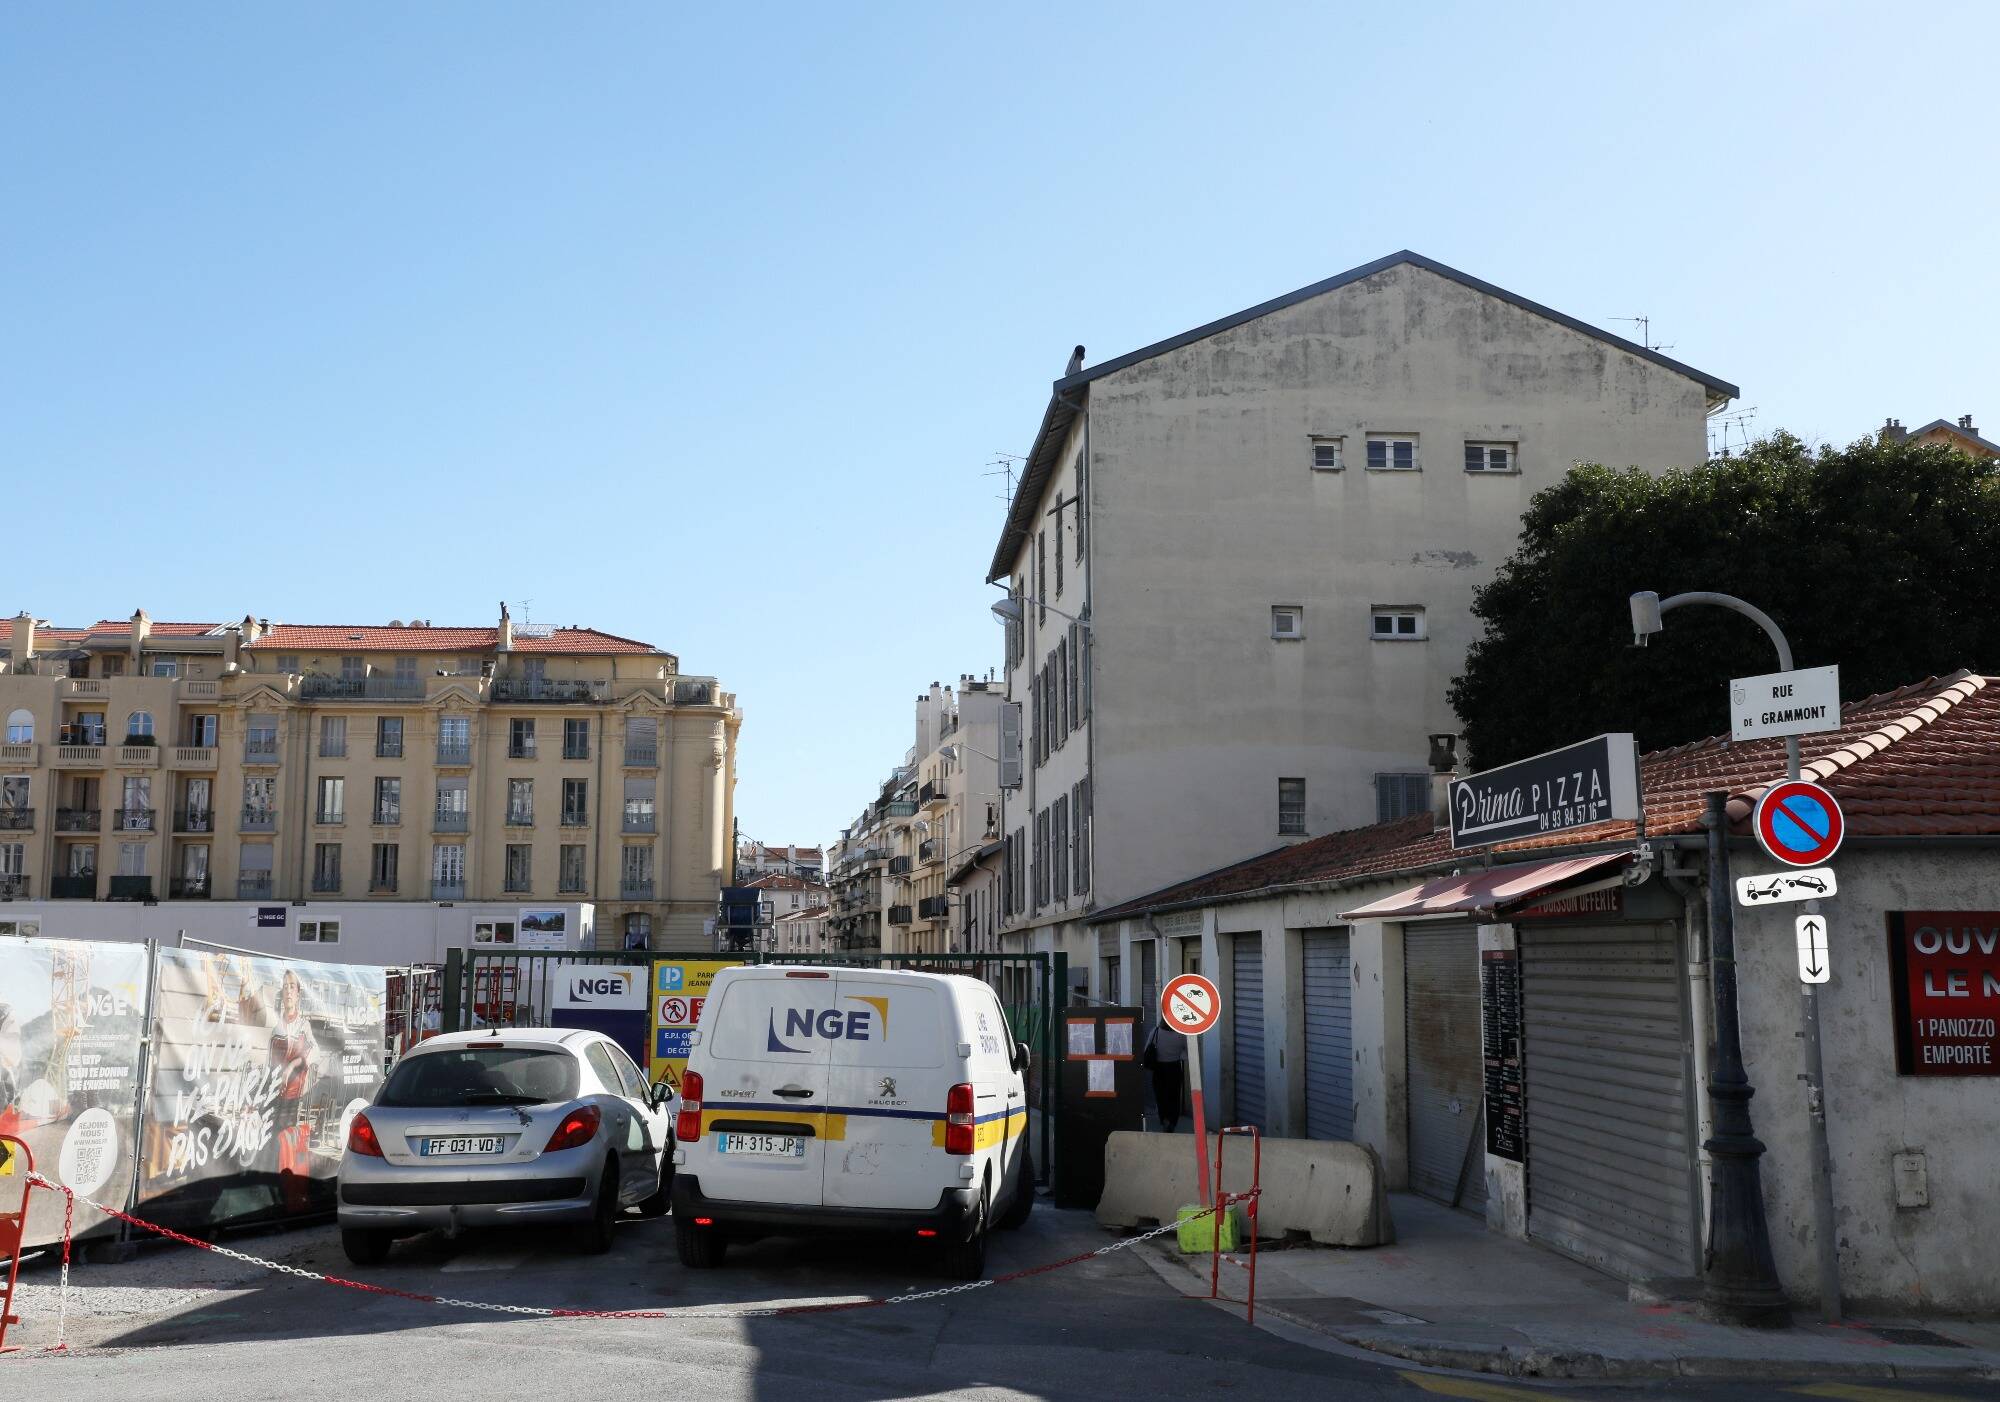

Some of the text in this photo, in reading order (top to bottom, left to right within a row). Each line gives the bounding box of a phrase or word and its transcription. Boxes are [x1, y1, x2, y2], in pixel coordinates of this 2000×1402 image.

[1772, 684, 1793, 699] RUE
[1743, 705, 1826, 727] DE GRAMMONT
[1456, 768, 1602, 831] Prima PIZZA
[1540, 802, 1597, 831] 04 93 84 57 16
[1580, 888, 1618, 912] OFFERTE
[1913, 926, 2000, 955] OUV
[578, 979, 623, 995] NGE
[1924, 969, 1970, 997] LE
[88, 993, 127, 1016] NGE
[785, 1008, 871, 1041] NGE
[1917, 1018, 1995, 1038] 1 PANOZZO
[68, 1054, 81, 1066] LE
[1923, 1042, 1992, 1064] EMPORTÉ
[99, 1066, 129, 1077] DONNE
[69, 1080, 82, 1091] DE
[720, 1089, 757, 1098] EXPERT
[79, 1121, 109, 1130] REJOINS
[166, 1126, 212, 1177] PAS
